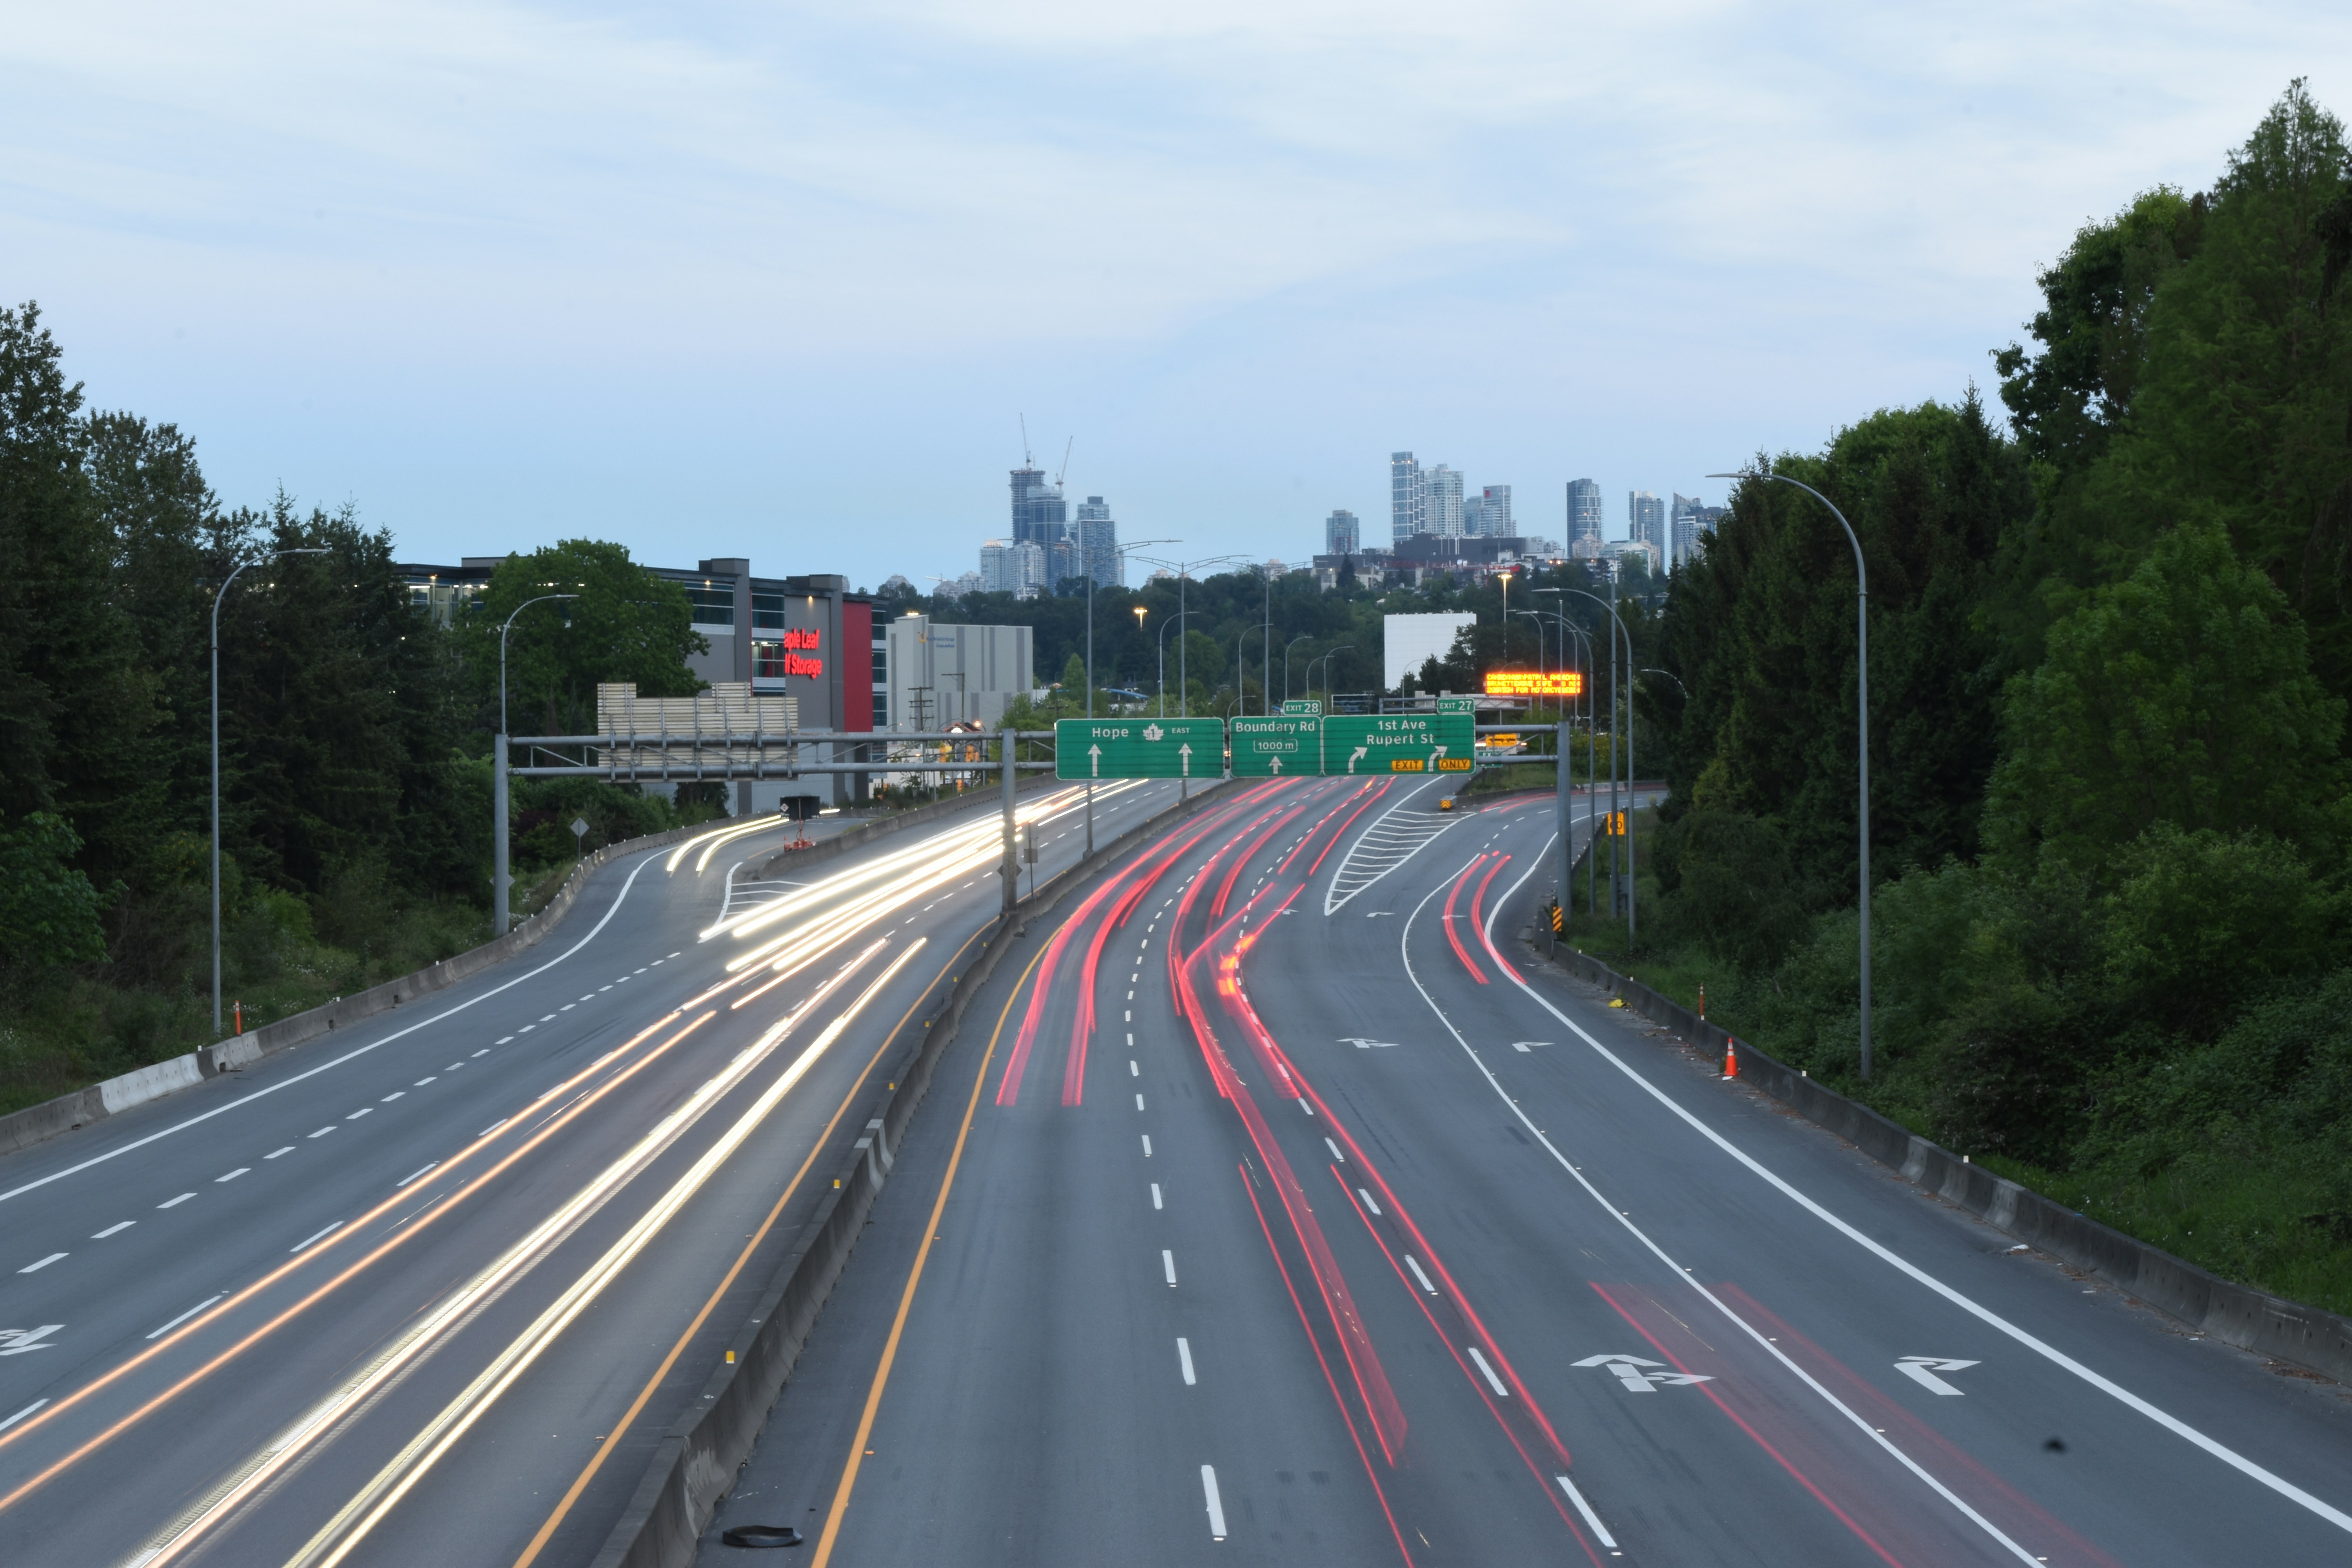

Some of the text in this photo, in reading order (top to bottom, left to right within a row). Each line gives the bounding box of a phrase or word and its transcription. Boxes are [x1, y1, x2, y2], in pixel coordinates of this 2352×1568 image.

[784, 628, 820, 652] aple Leaf
[791, 653, 822, 679] Storage
[1304, 703, 1319, 713] 28
[1458, 701, 1472, 711] 27
[1236, 721, 1315, 734] Boundary Rd
[1378, 720, 1426, 730] 1st Ave
[1092, 727, 1129, 740] Hope
[1151, 729, 1155, 738] 1
[1367, 733, 1434, 747] Rupert St
[1396, 760, 1468, 769] EXIT ONLY
